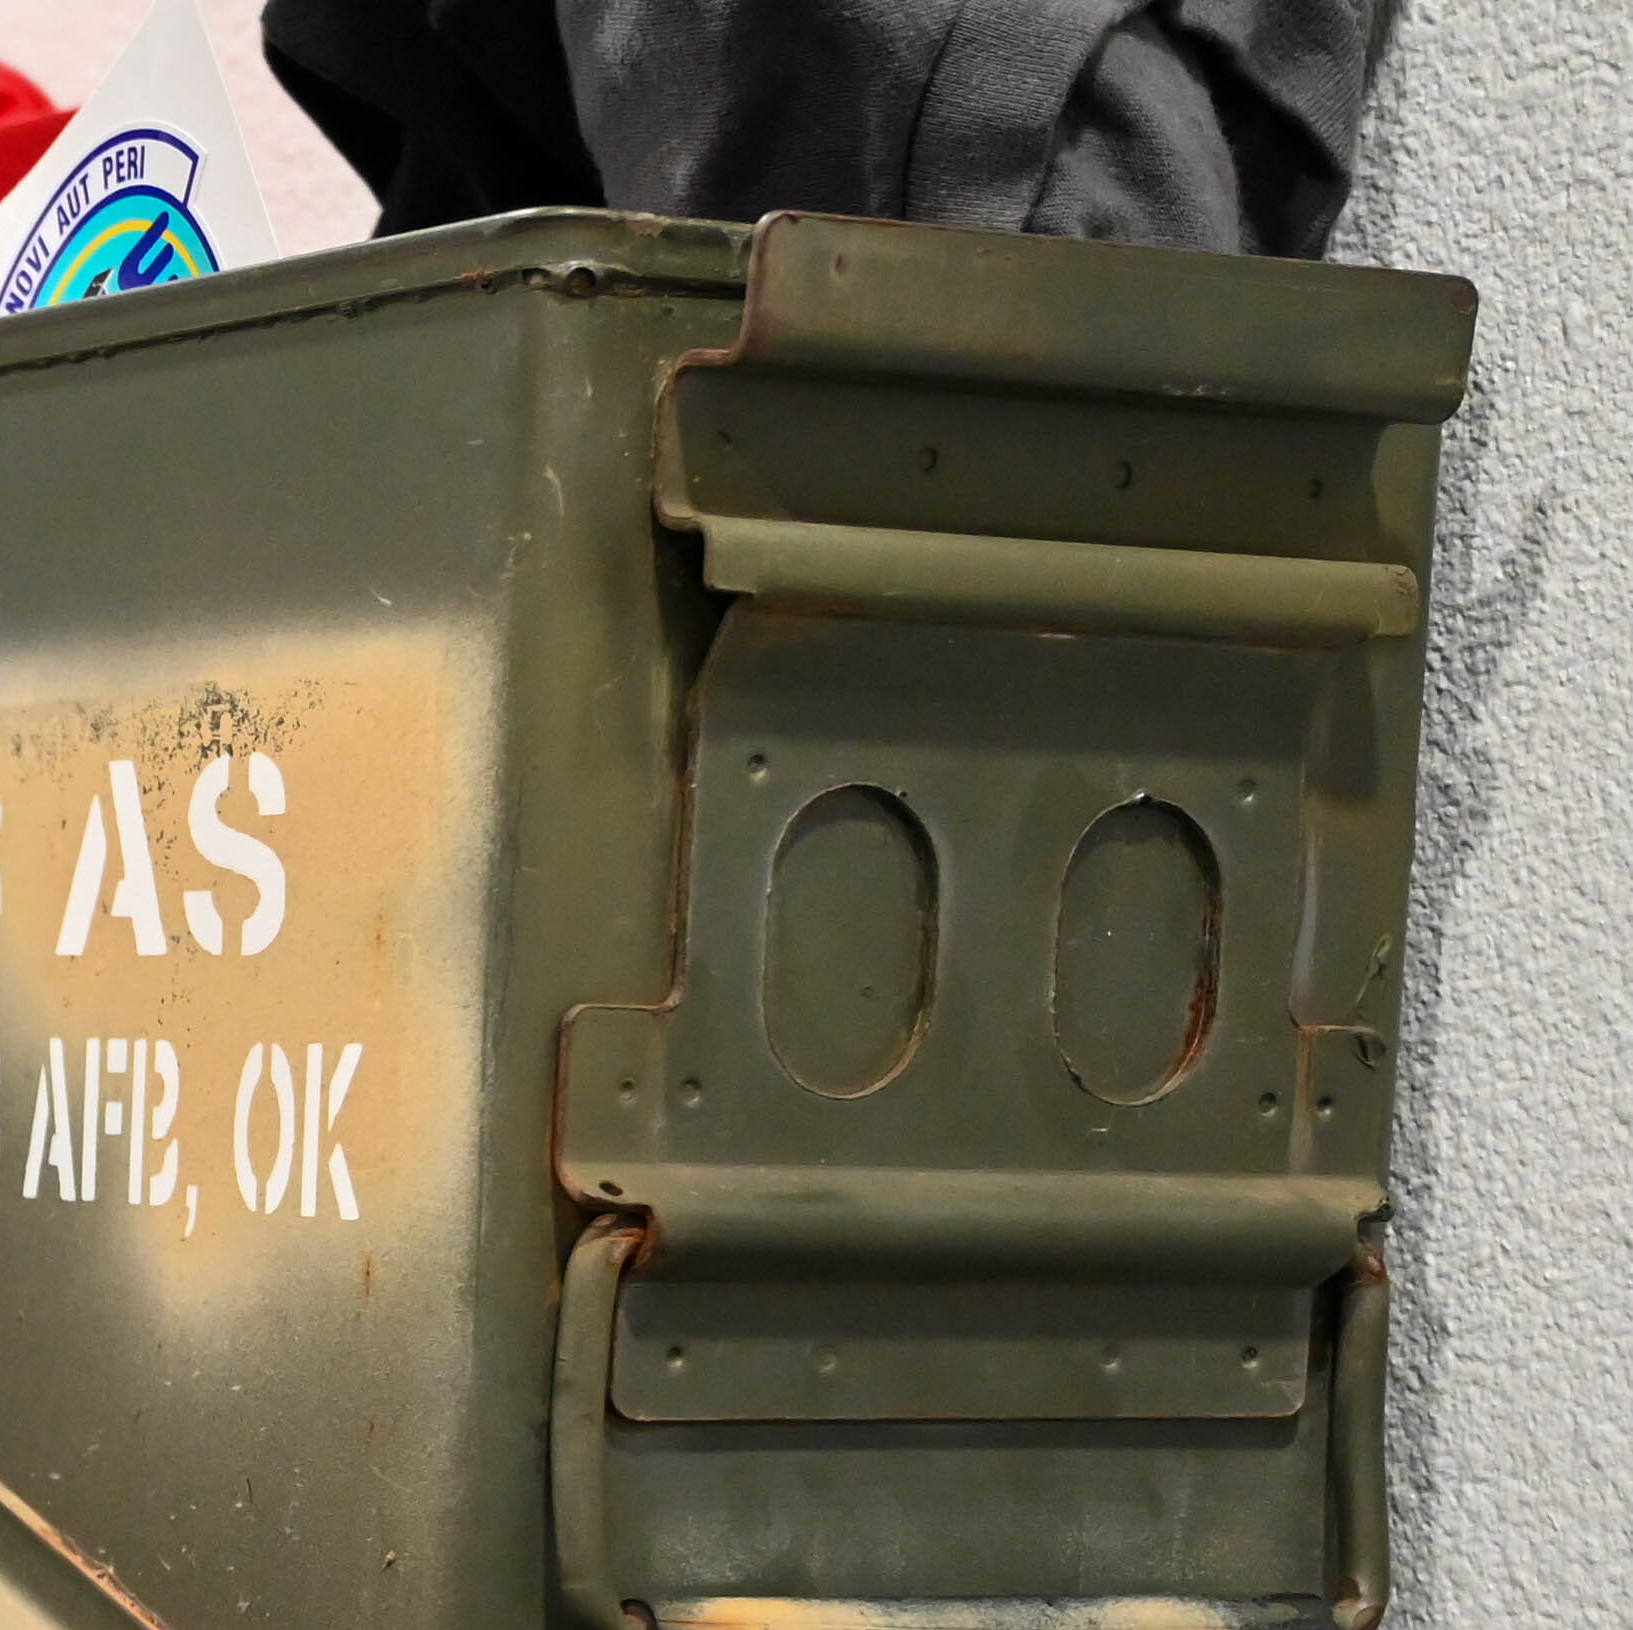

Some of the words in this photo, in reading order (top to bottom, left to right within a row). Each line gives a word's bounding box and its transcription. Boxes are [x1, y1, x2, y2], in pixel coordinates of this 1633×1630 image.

[4, 235, 50, 314] NOVI
[55, 172, 90, 236] AUT
[102, 144, 146, 190] PERI
[55, 751, 287, 956] AS
[23, 1037, 200, 1237] AFB,
[233, 1042, 363, 1221] OK
